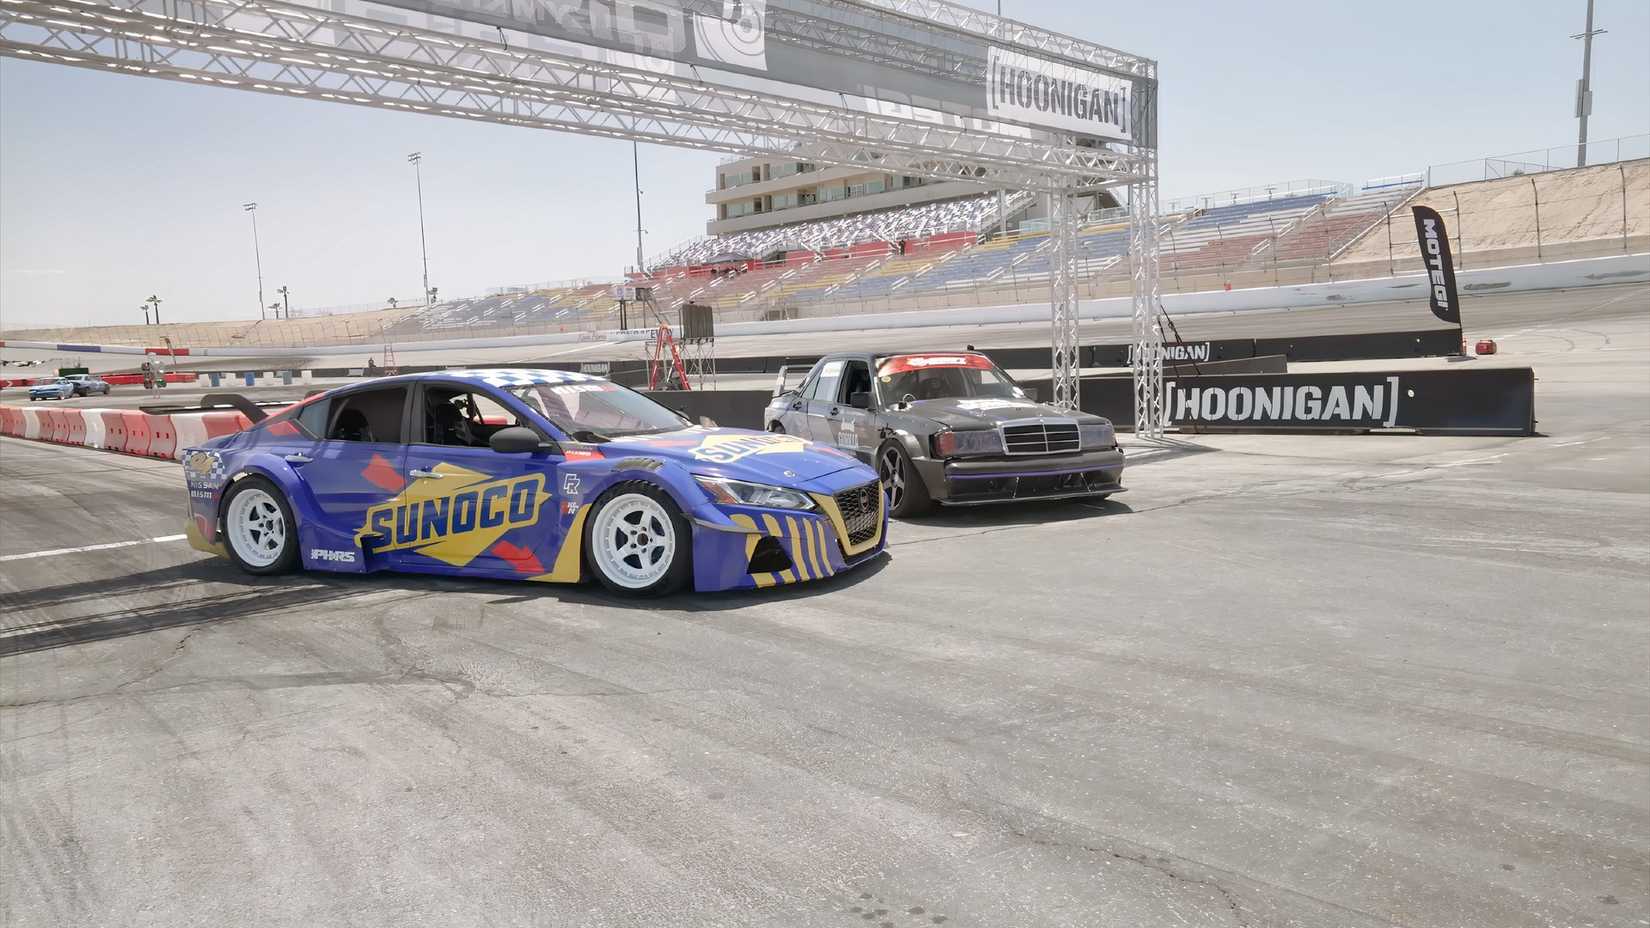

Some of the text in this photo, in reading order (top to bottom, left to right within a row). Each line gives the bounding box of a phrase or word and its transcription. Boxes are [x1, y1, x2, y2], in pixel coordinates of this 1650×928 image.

[992, 56, 1127, 133] [HOONIGAN]
[1423, 219, 1448, 308] MOTEGI
[1126, 342, 1210, 363] [NIGAN]
[1163, 376, 1399, 427] [HOONIGAN]
[371, 479, 539, 548] SUNOCO
